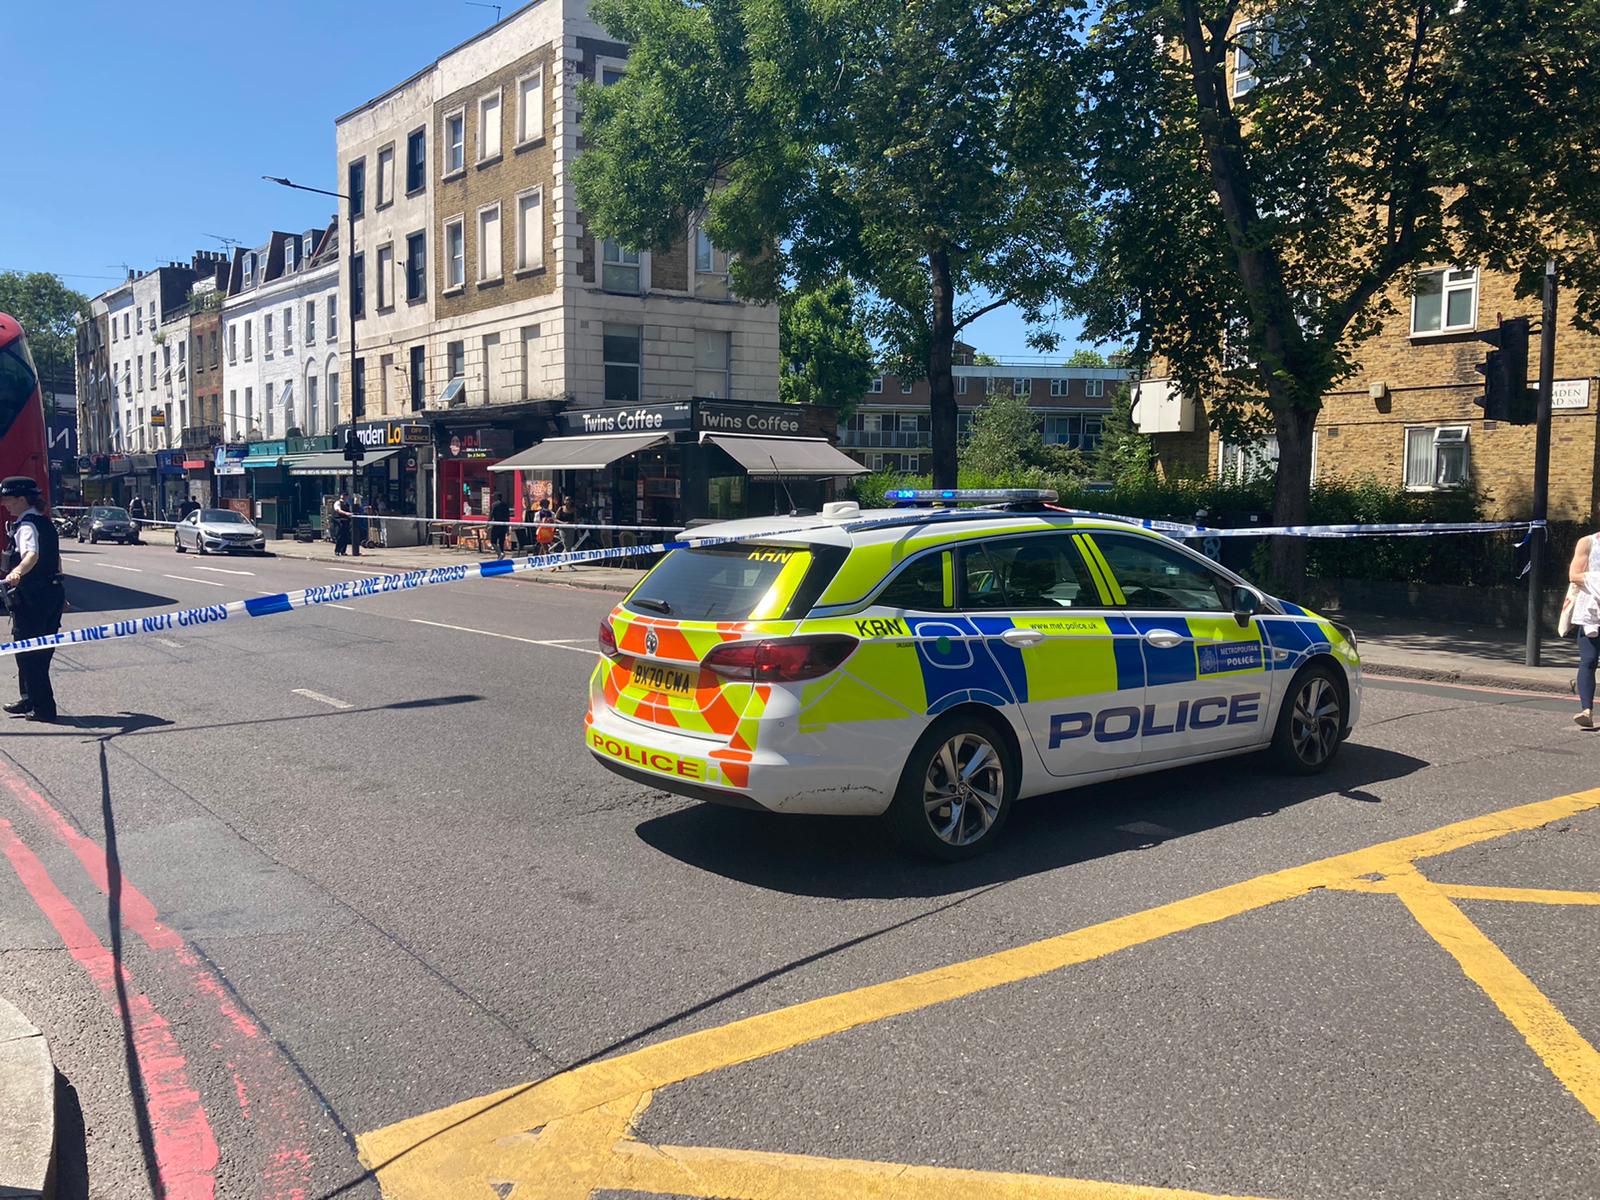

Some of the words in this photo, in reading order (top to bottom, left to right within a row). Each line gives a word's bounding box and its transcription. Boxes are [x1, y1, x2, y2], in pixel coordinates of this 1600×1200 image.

[582, 413, 615, 432] Twins
[617, 409, 663, 430] Coffee
[699, 411, 742, 429] Twins
[746, 414, 799, 432] Coffee
[345, 424, 385, 445] Cmden
[387, 422, 401, 444] Lo
[304, 582, 349, 605] POLICE
[352, 577, 380, 597] LINE
[382, 574, 401, 591] DO
[402, 570, 428, 588] NOT
[429, 565, 469, 583] CROSS
[71, 626, 108, 642] LINE
[178, 604, 228, 626] CROSS
[855, 619, 903, 636] KRN
[1029, 621, 1097, 630] www.met.police.uk
[1220, 645, 1258, 655] METROPOLITAN
[1226, 656, 1255, 666] POLICE
[634, 665, 663, 688] BX70
[665, 671, 690, 694] CWA
[1048, 692, 1261, 749] POLICE
[593, 734, 700, 779] POLICE
